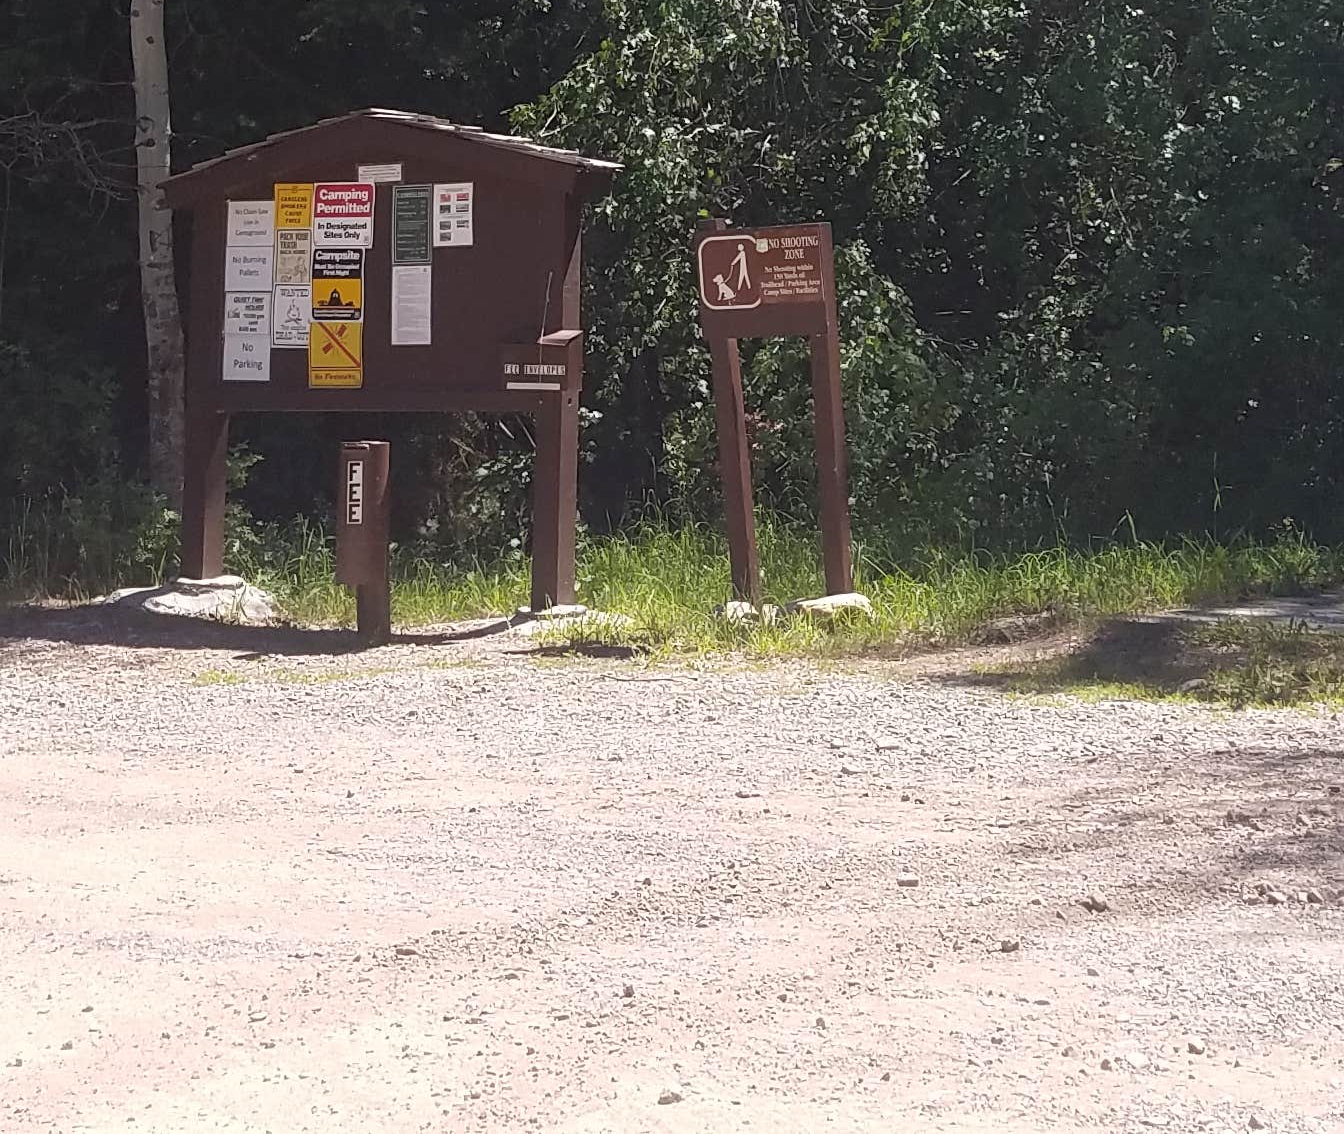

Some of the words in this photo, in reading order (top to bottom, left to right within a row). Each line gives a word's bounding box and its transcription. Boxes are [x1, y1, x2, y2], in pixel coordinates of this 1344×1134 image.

[319, 188, 369, 202] Camping
[316, 202, 371, 214] Permitted
[317, 222, 325, 230] In
[326, 222, 367, 231] Designated
[324, 231, 342, 239] Sites
[344, 231, 360, 240] Only
[769, 238, 780, 249] NO
[781, 236, 818, 248] SHOOTING
[315, 250, 360, 262] Campsite
[784, 248, 805, 260] ZONE
[242, 256, 266, 265] Burning
[242, 343, 253, 352] No
[233, 359, 263, 370] Parking
[349, 462, 361, 523] FEE
